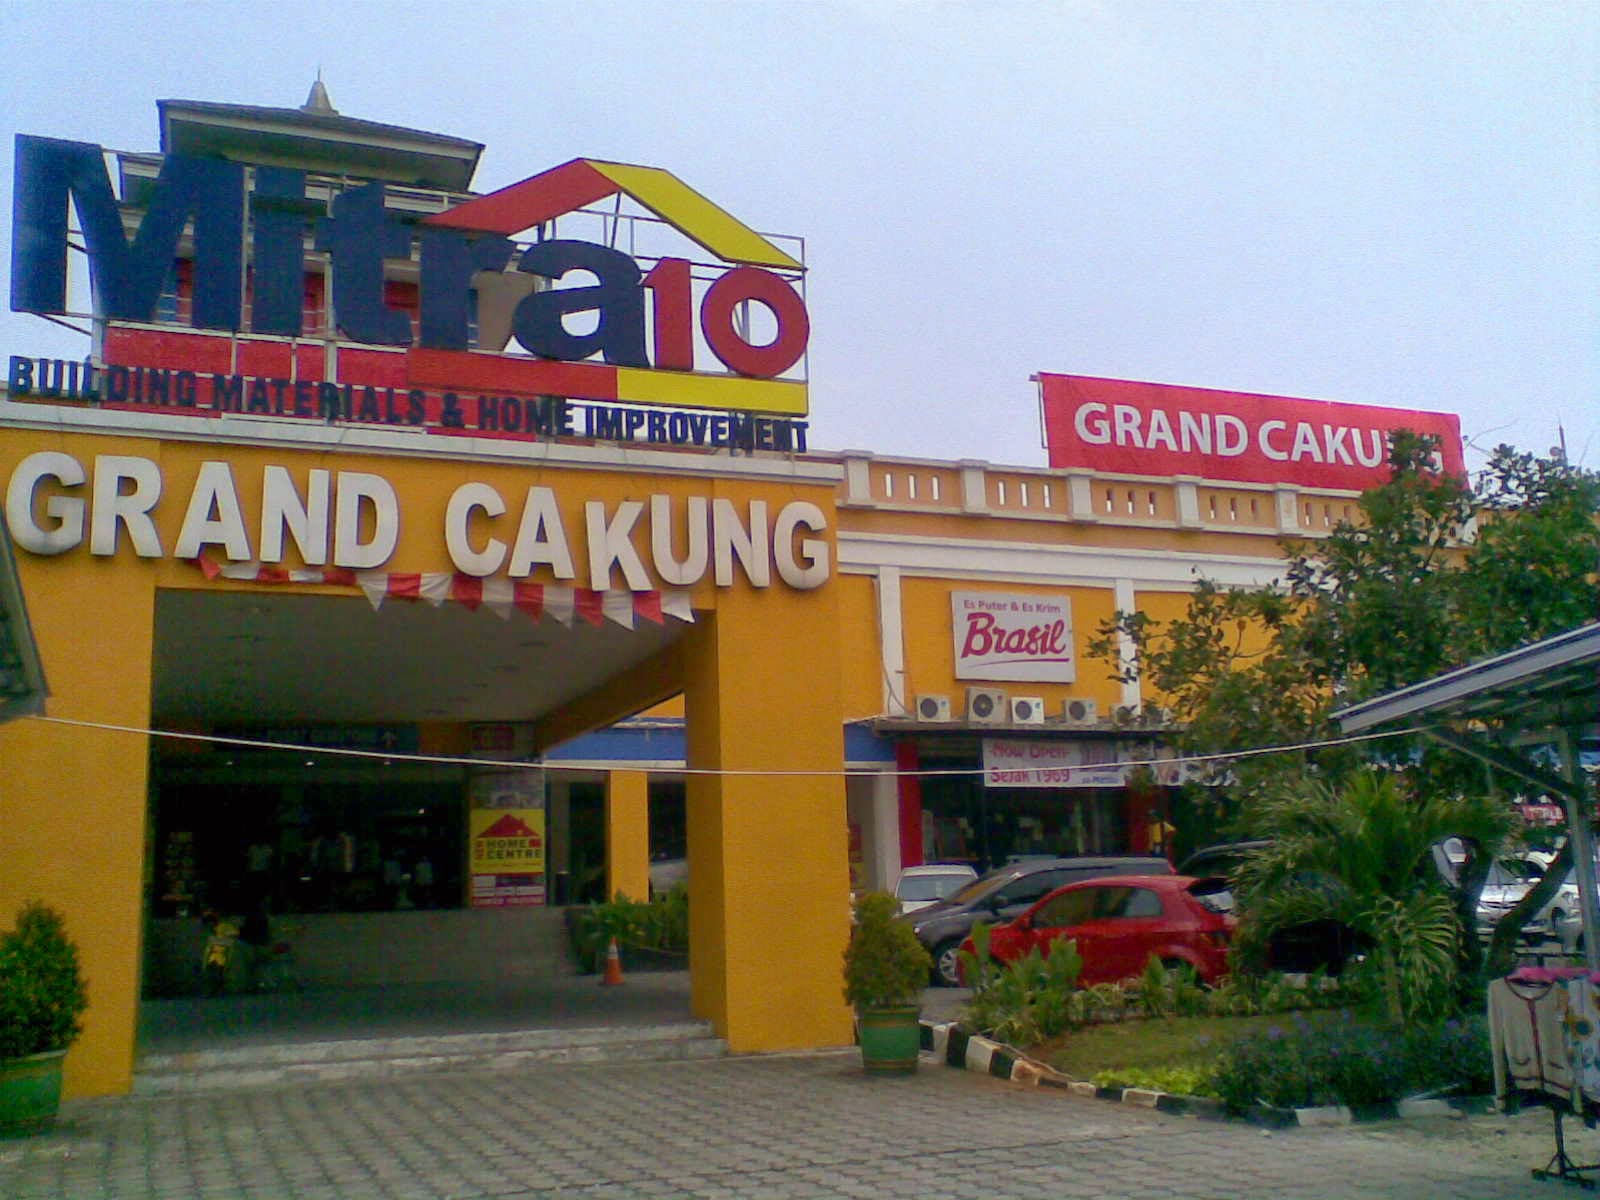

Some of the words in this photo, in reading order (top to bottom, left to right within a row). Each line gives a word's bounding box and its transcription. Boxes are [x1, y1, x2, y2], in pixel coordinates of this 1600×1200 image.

[9, 355, 196, 401] BUILDING
[212, 374, 427, 426] MATERIALS
[441, 392, 464, 428] &
[478, 394, 576, 436] HOME
[585, 405, 810, 455] IMPROVEMENT
[1074, 402, 1248, 456] GRAND
[5, 451, 399, 568] GRAND
[445, 482, 830, 592] CAKUNG
[963, 599, 976, 609] Es
[1010, 601, 1020, 612] &
[1022, 602, 1034, 613] Es
[960, 611, 1067, 659] Brasil
[486, 838, 528, 849] HOME
[486, 848, 543, 860] CENTRE
